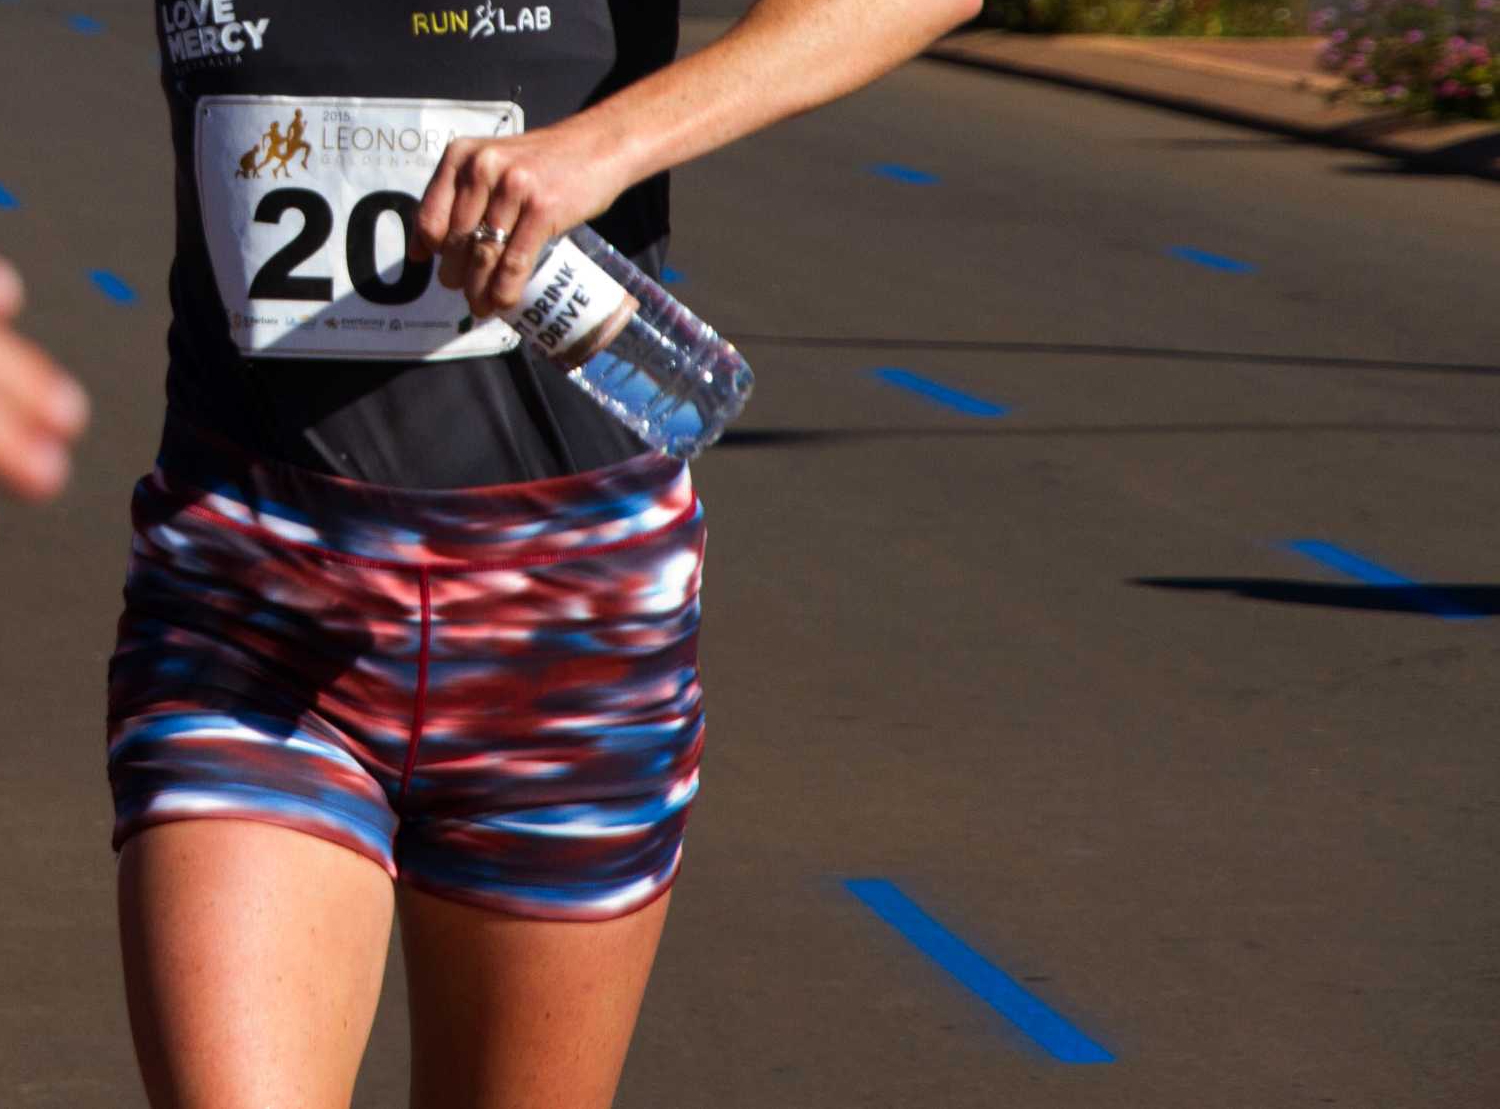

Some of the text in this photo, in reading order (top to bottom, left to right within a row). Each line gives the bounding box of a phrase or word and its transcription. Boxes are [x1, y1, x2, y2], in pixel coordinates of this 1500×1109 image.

[167, 17, 270, 63] MERCY
[412, 5, 551, 35] RUN LAB
[521, 259, 579, 327] DRINK
